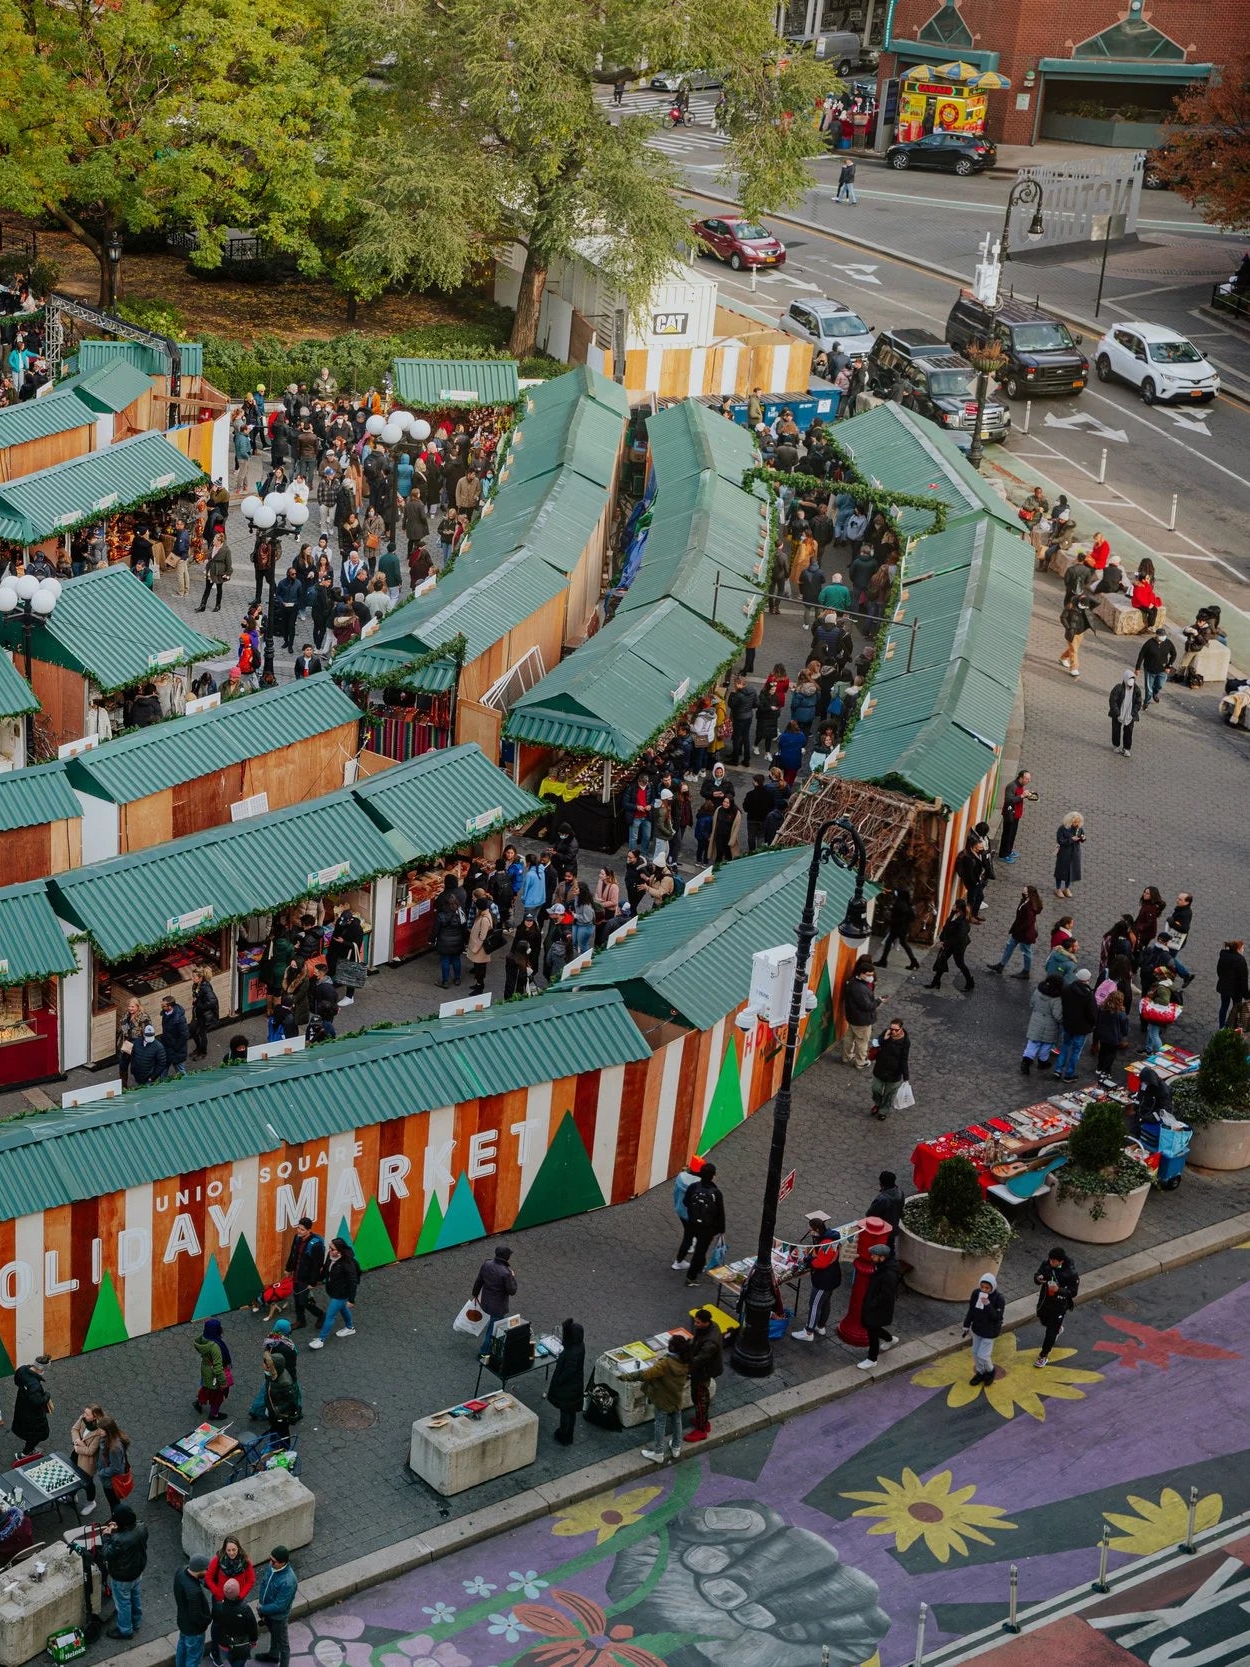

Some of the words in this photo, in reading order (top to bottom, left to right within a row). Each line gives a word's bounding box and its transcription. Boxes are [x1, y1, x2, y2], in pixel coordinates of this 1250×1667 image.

[656, 315, 685, 333] CAT
[155, 1175, 243, 1212] UNION
[259, 1141, 363, 1183] SQUARE
[275, 1119, 540, 1232] MARKET
